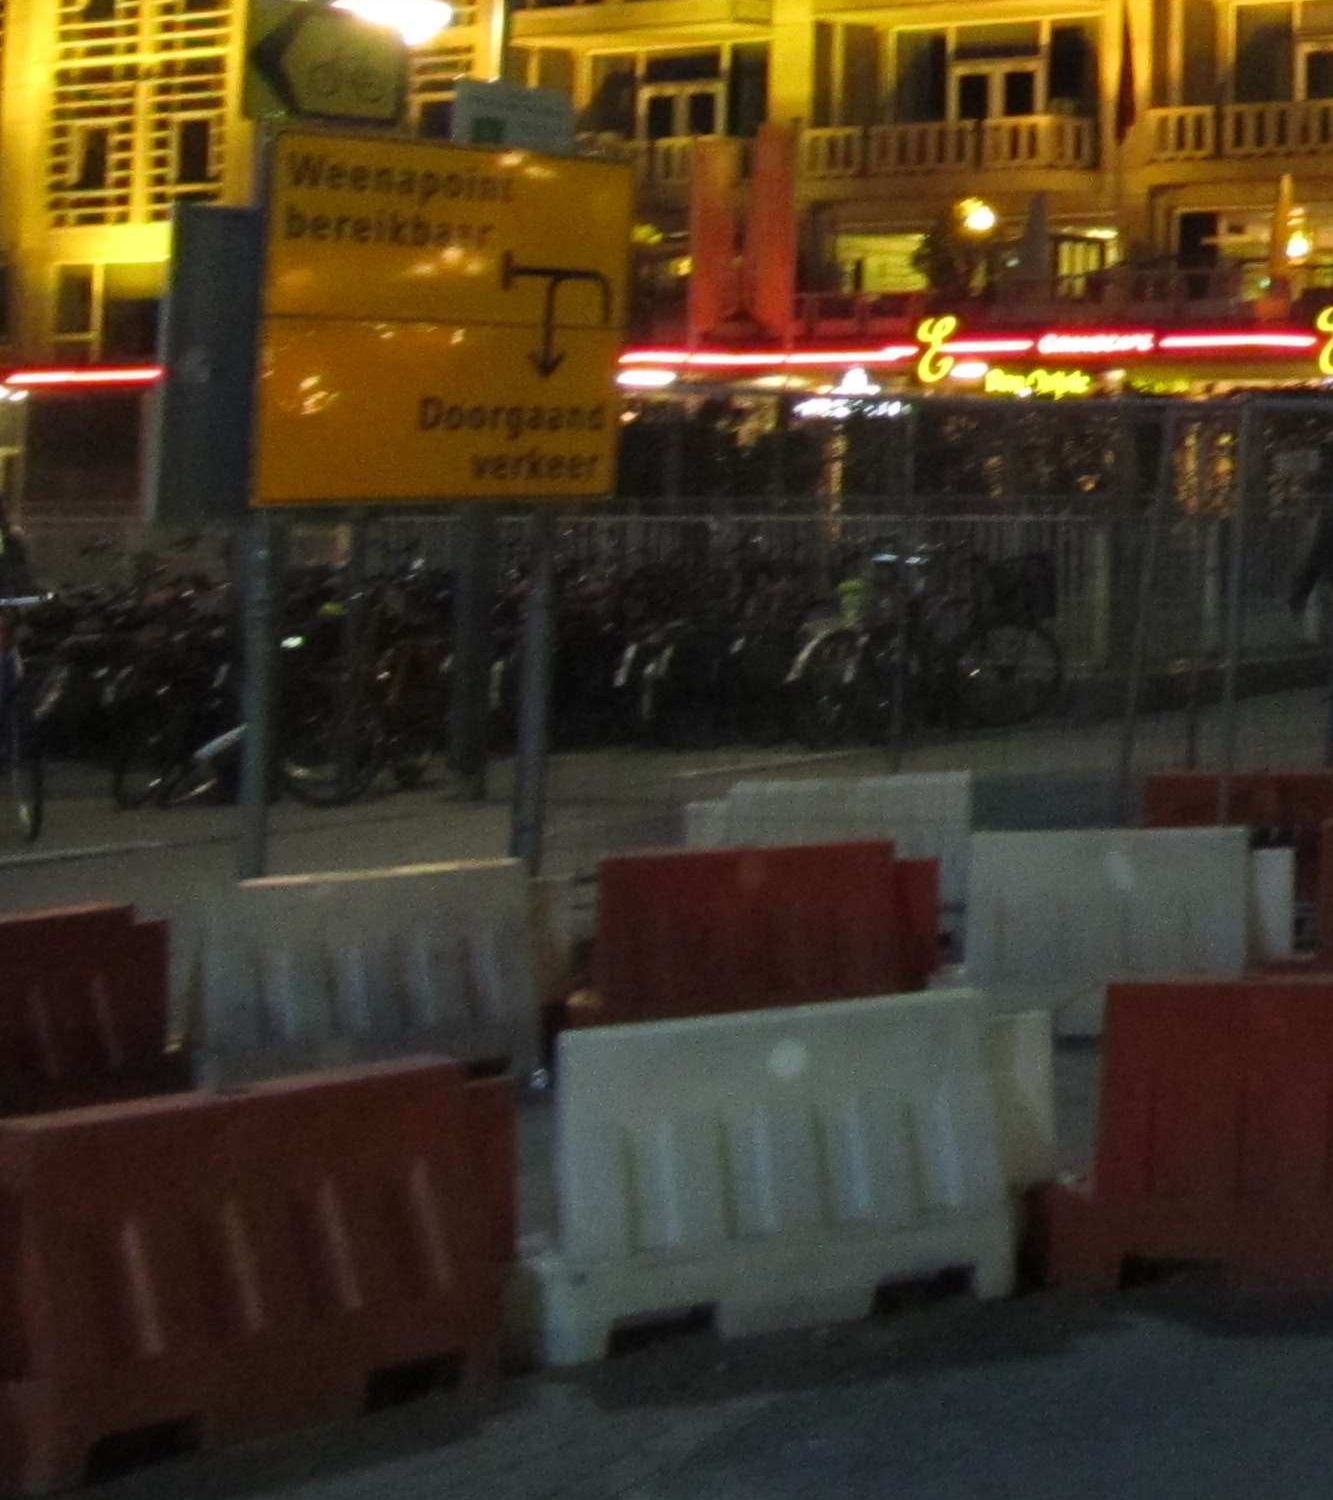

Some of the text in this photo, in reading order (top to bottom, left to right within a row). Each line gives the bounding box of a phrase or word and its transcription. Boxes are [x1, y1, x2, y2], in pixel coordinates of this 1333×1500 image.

[285, 203, 494, 248] bereikbaar
[419, 397, 604, 441] Doorgaand
[471, 446, 599, 481] verkeer
